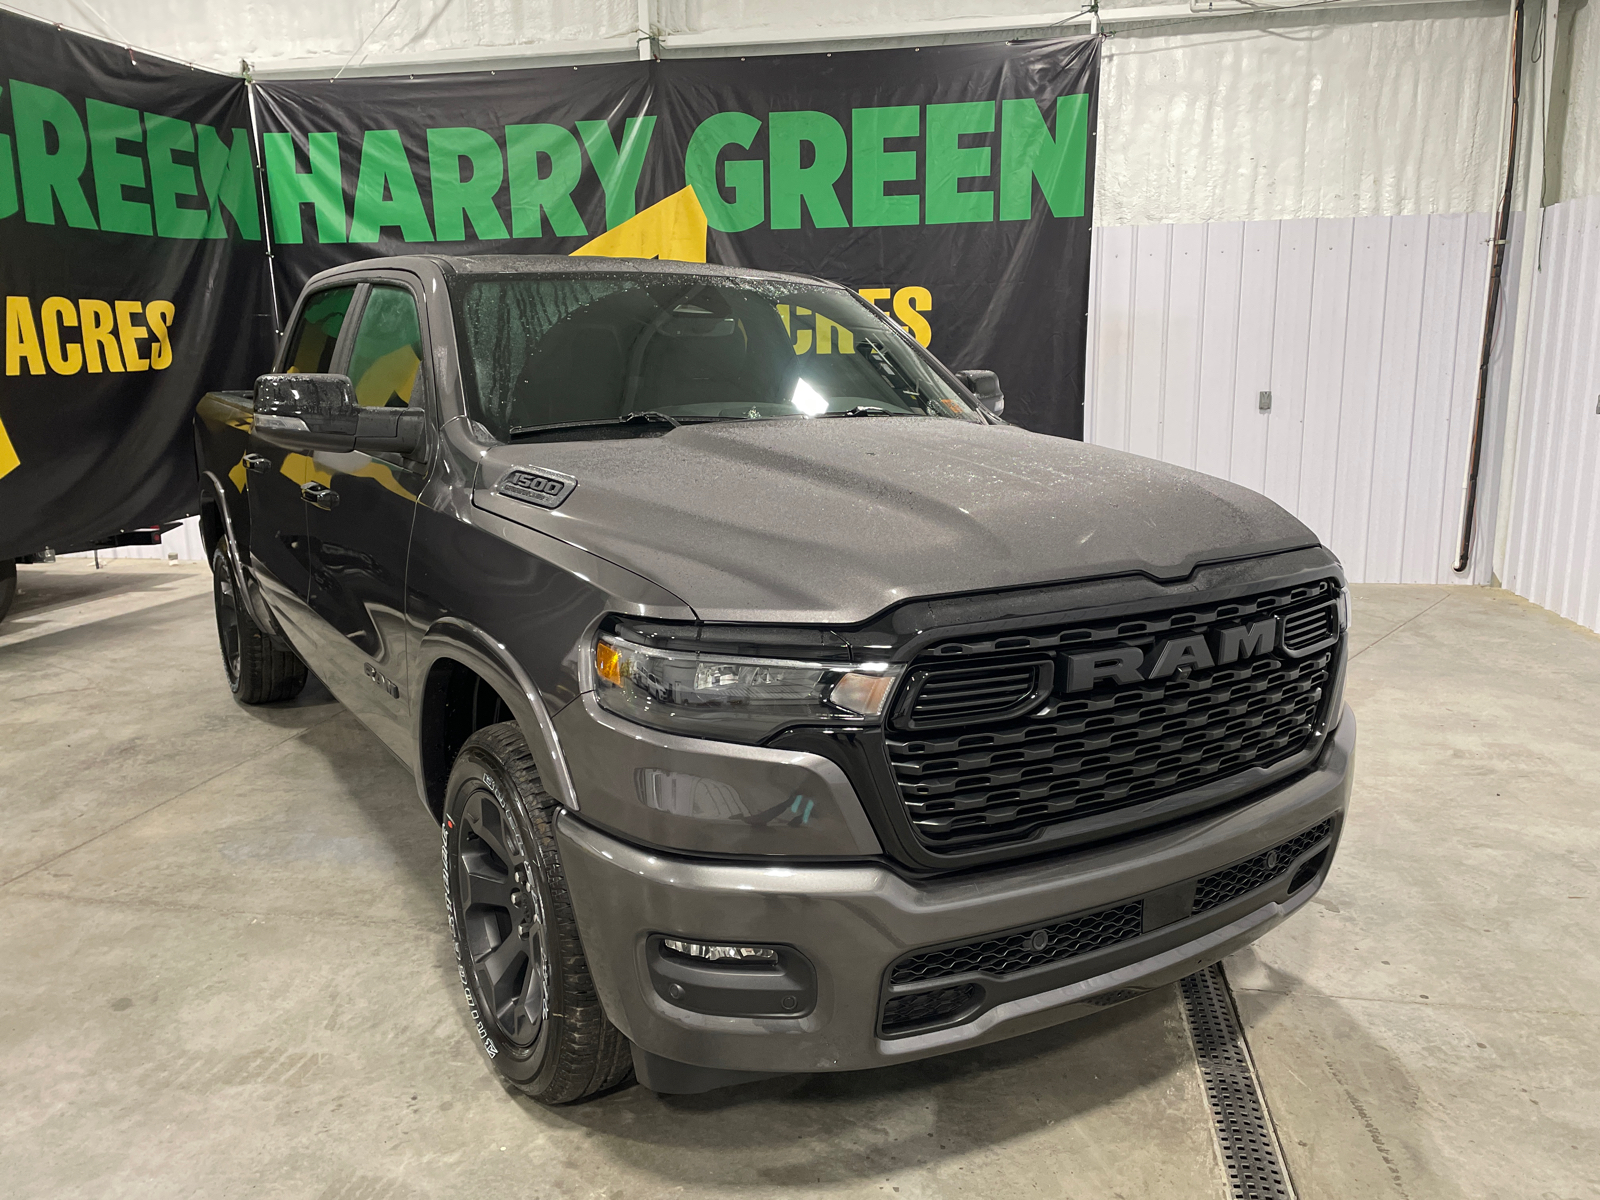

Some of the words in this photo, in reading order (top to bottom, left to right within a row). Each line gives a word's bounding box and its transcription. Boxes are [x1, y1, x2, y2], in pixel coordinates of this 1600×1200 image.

[263, 116, 657, 245] HARRY
[684, 93, 1090, 234] GREEN
[5, 296, 176, 377] ACRES
[512, 472, 563, 496] 1500
[1066, 617, 1277, 694] RAM
